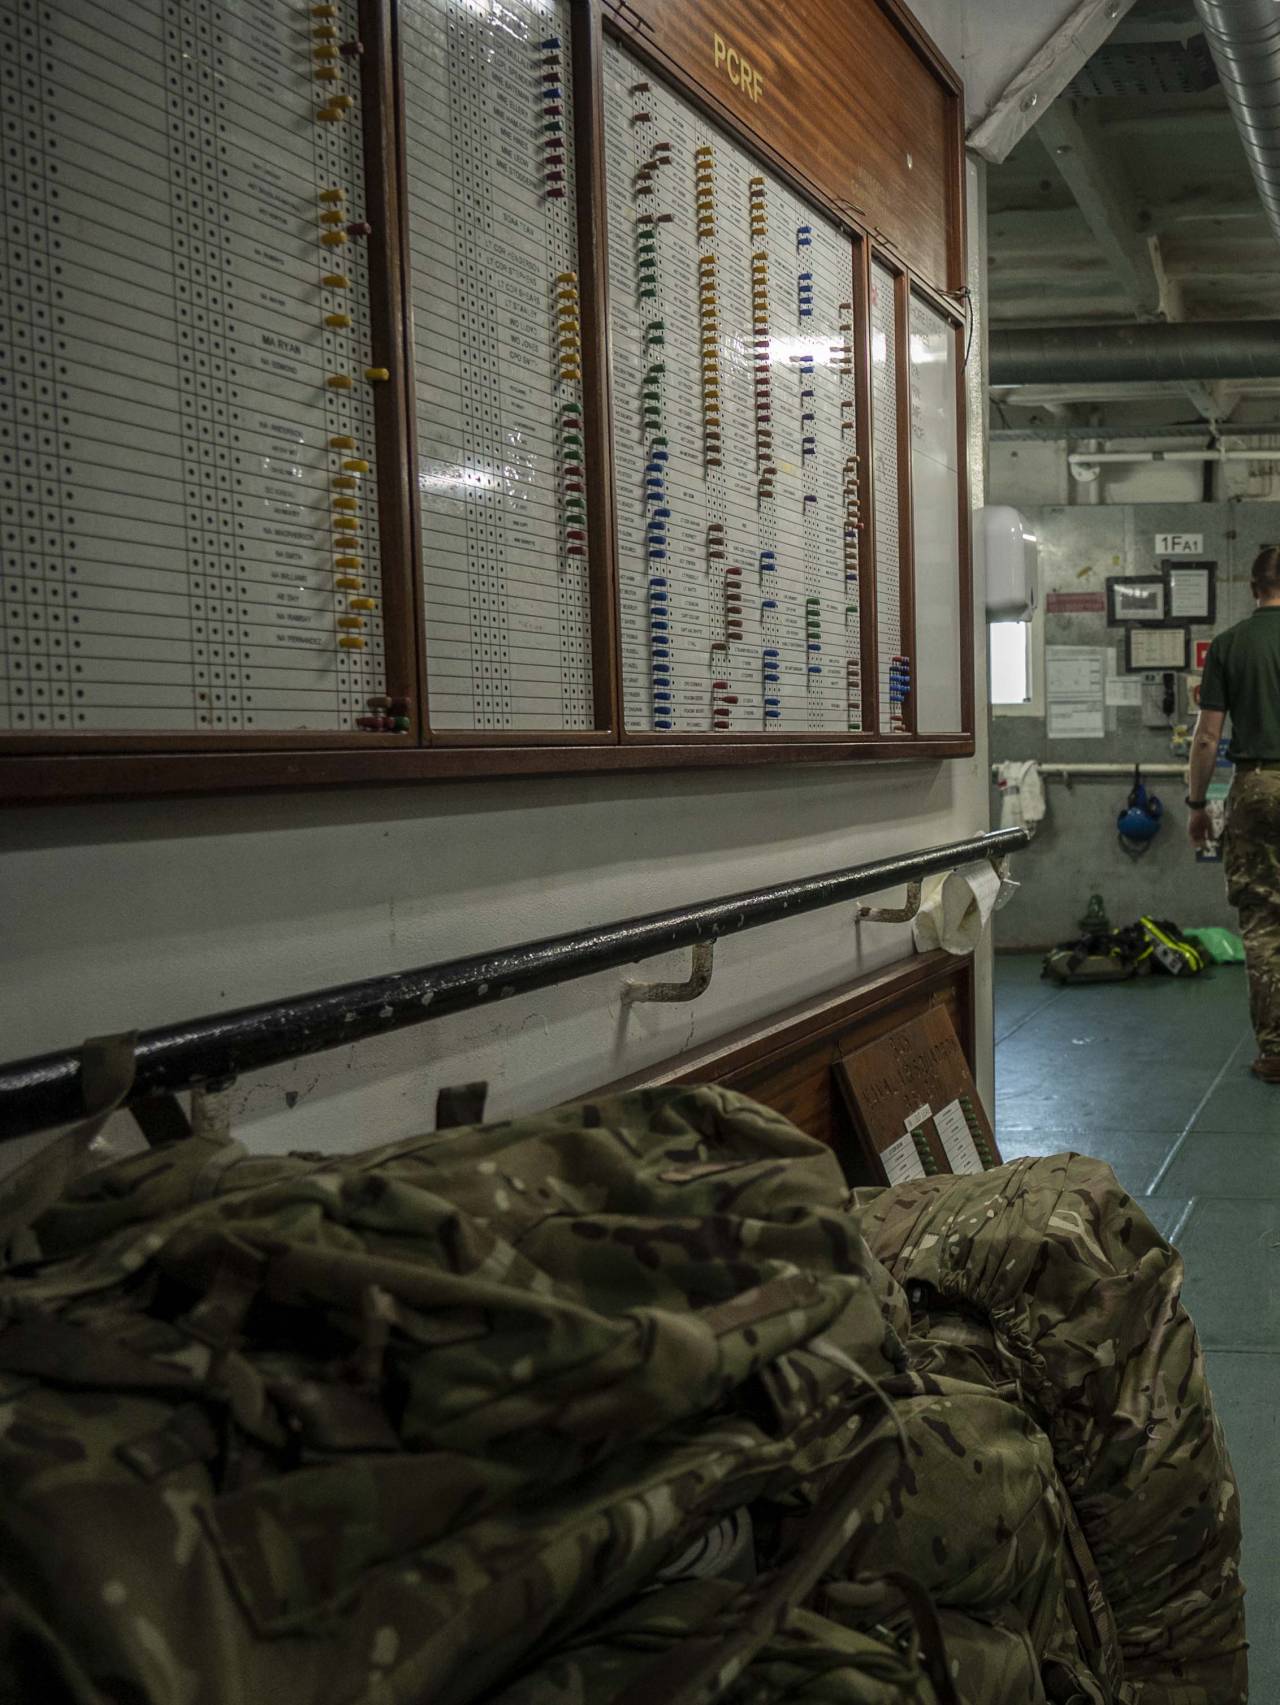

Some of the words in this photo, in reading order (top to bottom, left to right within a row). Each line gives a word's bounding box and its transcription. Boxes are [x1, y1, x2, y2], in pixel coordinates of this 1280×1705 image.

[713, 32, 764, 103] PCRF
[262, 333, 275, 347] MA
[277, 338, 301, 355] RYAN
[1161, 535, 1198, 552] 1FA1
